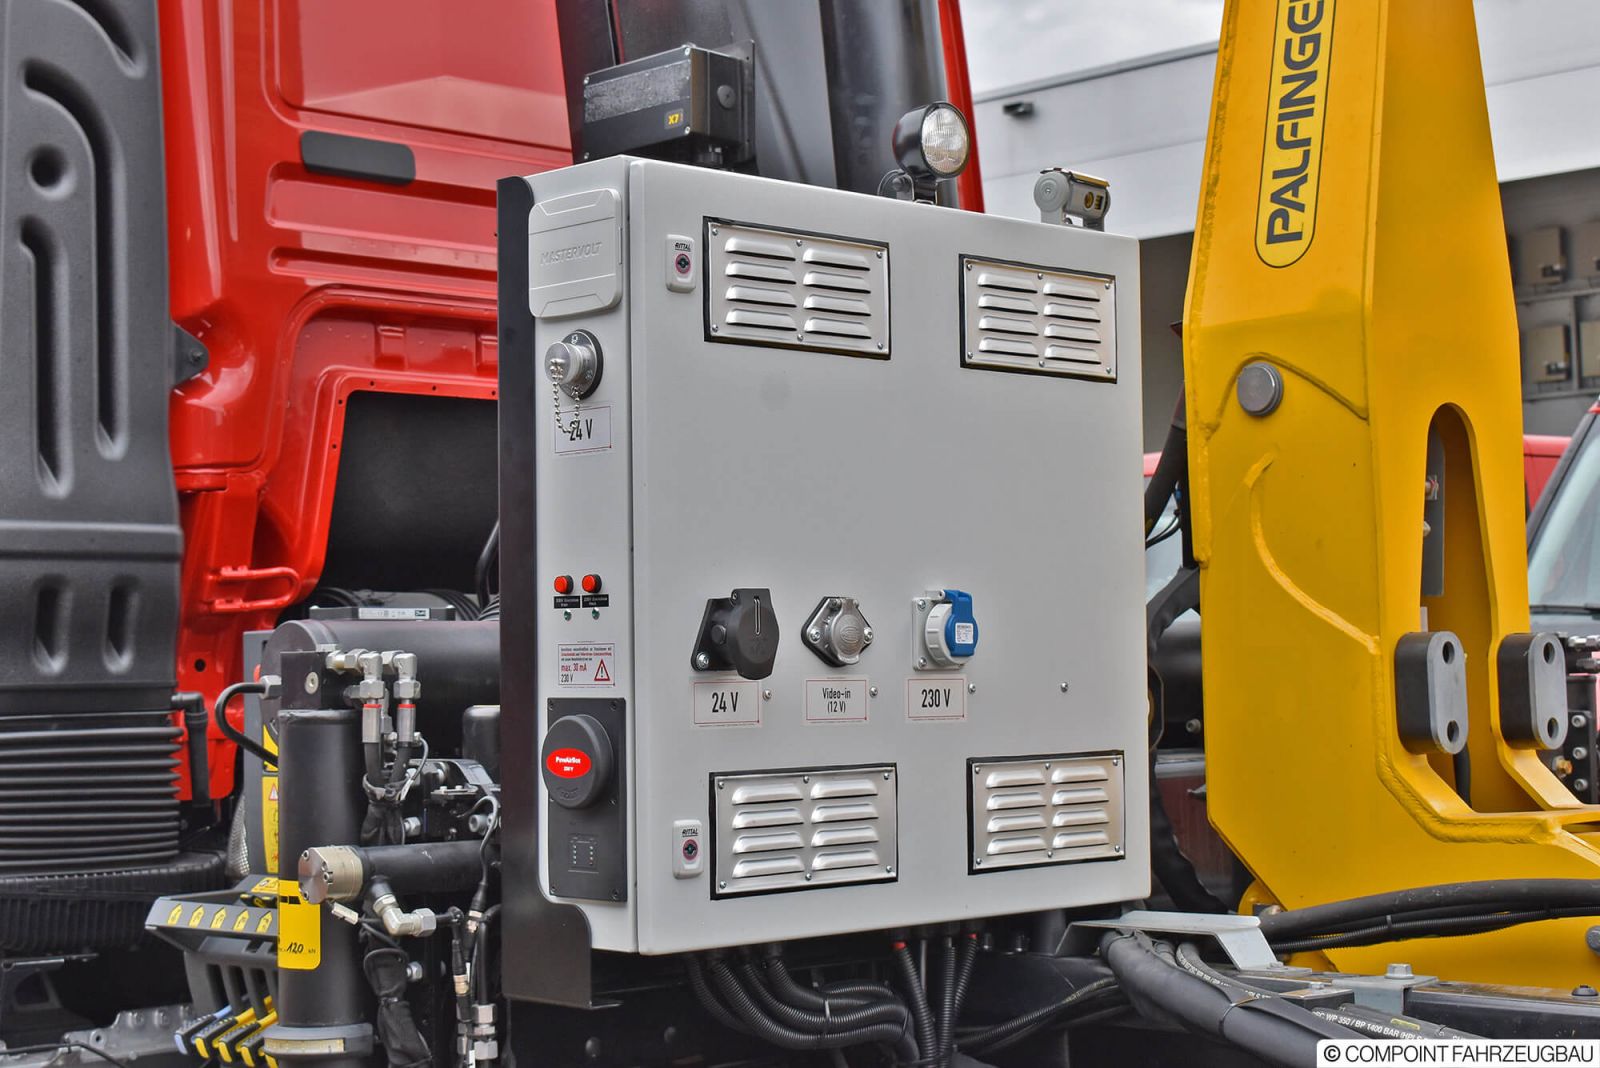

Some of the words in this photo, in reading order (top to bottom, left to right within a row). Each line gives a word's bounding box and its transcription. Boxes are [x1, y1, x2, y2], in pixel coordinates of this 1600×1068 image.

[1266, 0, 1324, 245] PALFINGE
[540, 241, 602, 266] MASTERVOLT
[675, 242, 691, 250] RITTAL
[569, 419, 582, 441] 24
[585, 418, 592, 440] V
[561, 673, 569, 683] 230
[711, 691, 727, 713] 24
[730, 691, 739, 713] V
[822, 687, 851, 700] Video-in
[921, 688, 941, 708] 230
[943, 688, 951, 708] V
[827, 700, 838, 713] (12
[839, 700, 846, 713] V)
[286, 941, 304, 954] 120
[1326, 1013, 1338, 1022] WP
[1338, 1016, 1351, 1026] 350
[1355, 1019, 1366, 1029] BP
[1367, 1023, 1382, 1034] 1400
[1383, 1027, 1400, 1038] BAR
